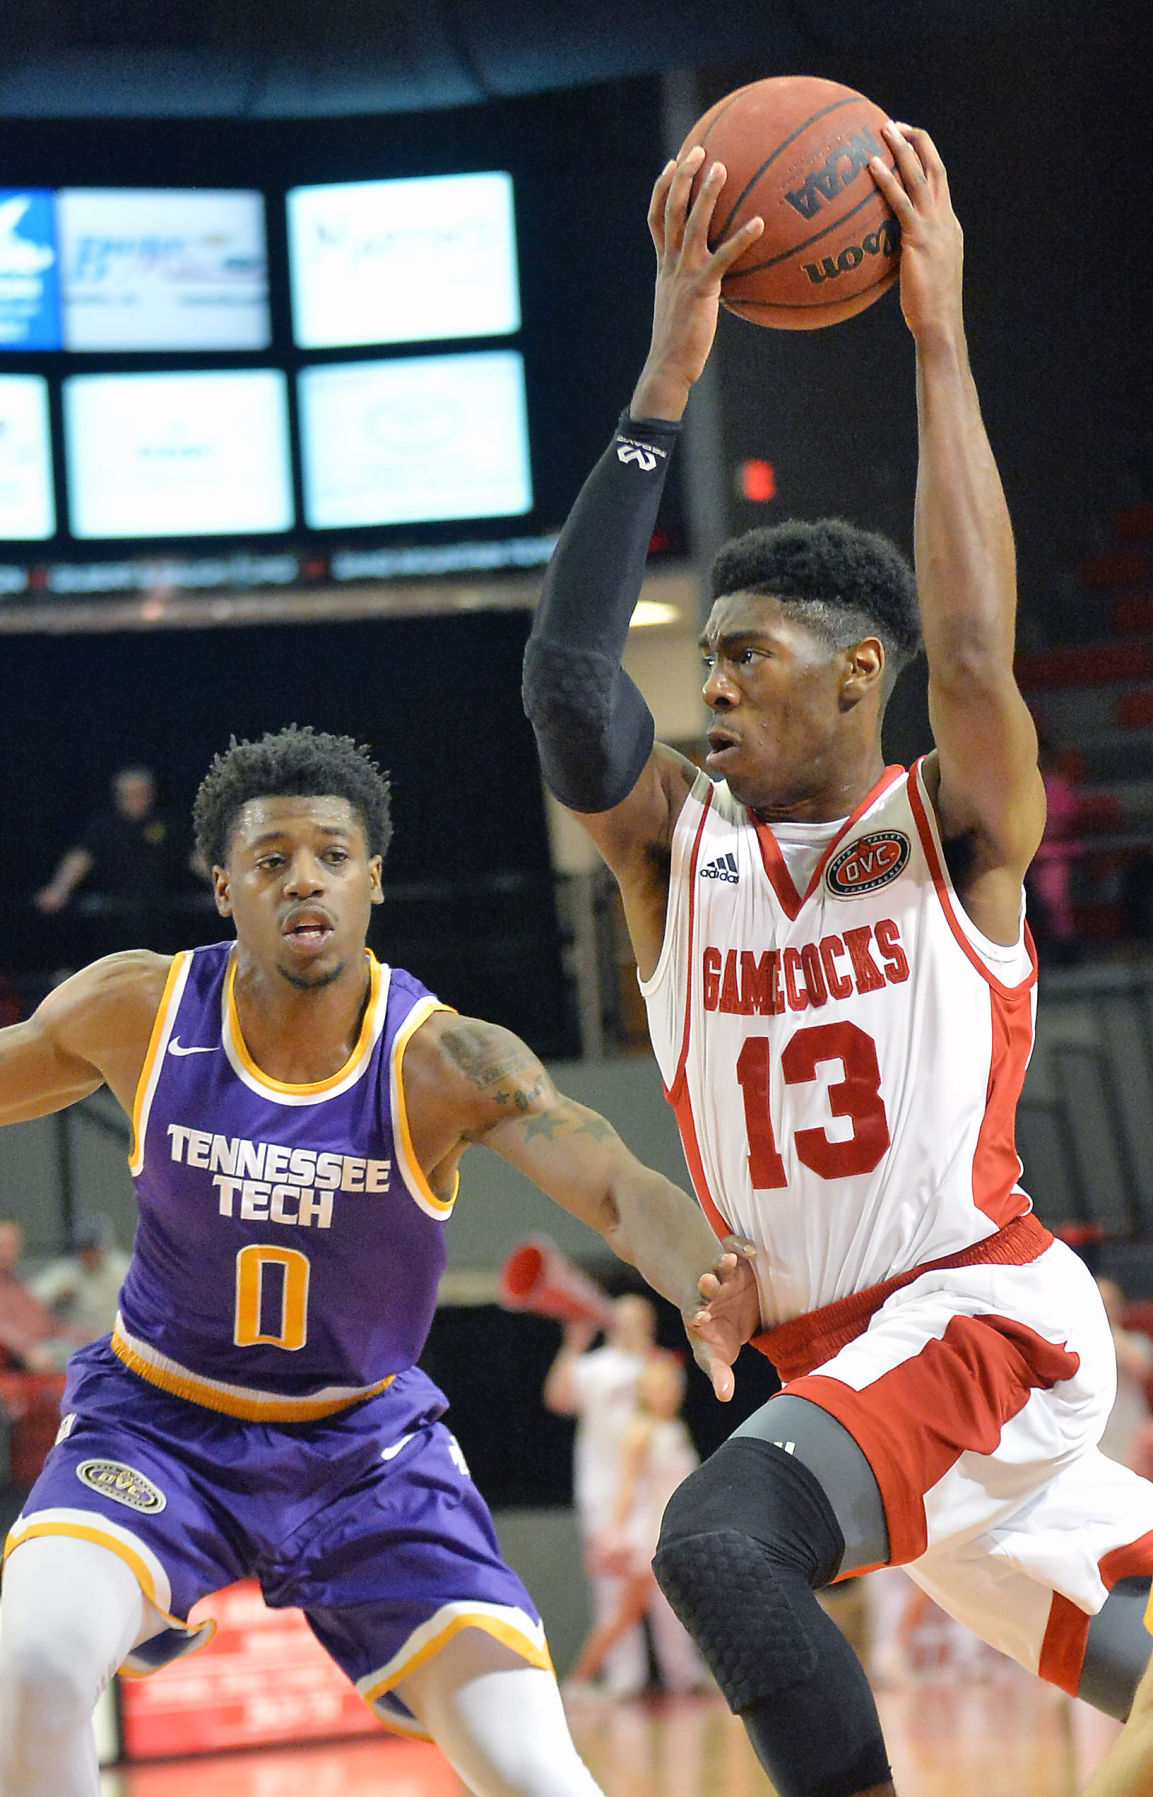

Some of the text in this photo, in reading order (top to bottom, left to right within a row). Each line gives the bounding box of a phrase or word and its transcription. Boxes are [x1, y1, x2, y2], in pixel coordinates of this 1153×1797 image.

[784, 126, 883, 219] NCAA
[802, 219, 902, 284] lson
[700, 867, 739, 884] adidas
[846, 844, 890, 881] OVC
[703, 918, 910, 1015] GAMECOCKS
[736, 1020, 891, 1190] 13
[167, 1123, 391, 1193] TENNESSEE
[212, 1174, 334, 1229] TECH
[233, 1244, 310, 1351] 0
[97, 1472, 146, 1500] OVC
